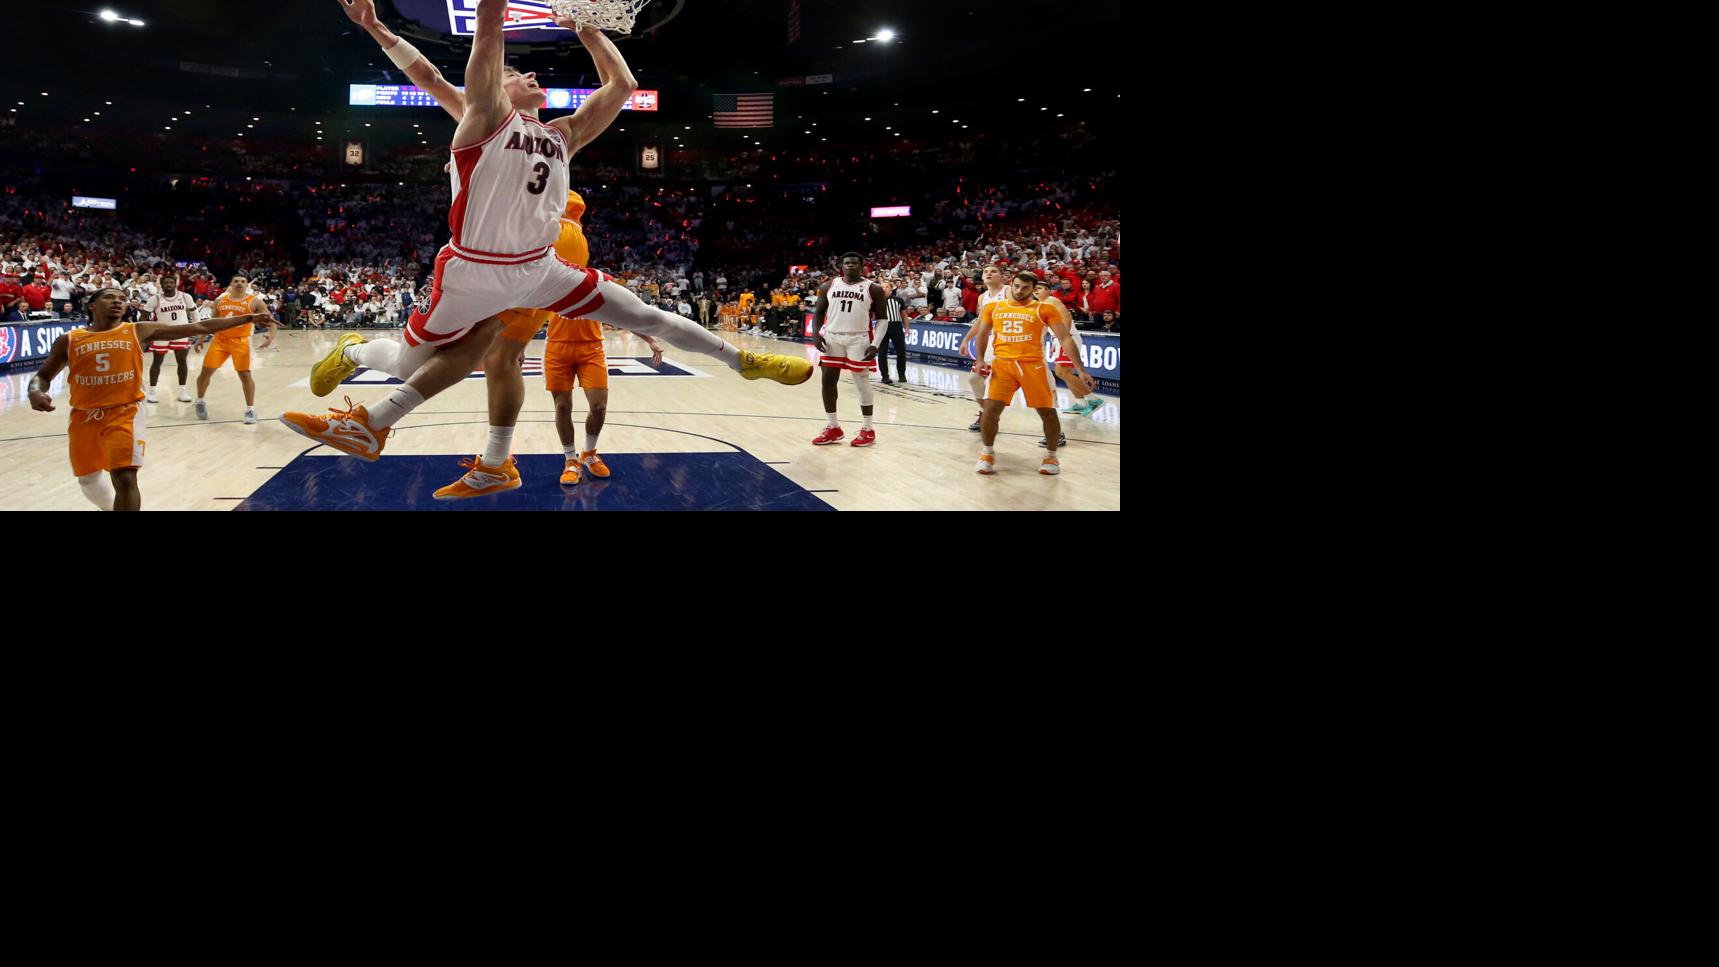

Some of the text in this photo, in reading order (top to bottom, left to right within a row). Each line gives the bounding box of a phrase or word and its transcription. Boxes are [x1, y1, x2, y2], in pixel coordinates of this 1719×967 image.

[527, 161, 550, 195] 3
[832, 290, 865, 302] ARIZONA
[160, 304, 185, 313] ARIZONA
[840, 300, 853, 312] 11
[171, 312, 177, 320] 0
[995, 312, 1035, 323] TENNESSEE
[1002, 320, 1024, 333] 25
[21, 329, 32, 357] A
[74, 340, 132, 356] TENNESSEE
[921, 330, 960, 350] ABOVE
[95, 352, 111, 372] 5
[1081, 344, 1120, 371] ABO
[74, 369, 135, 385] VOLUNTEERS
